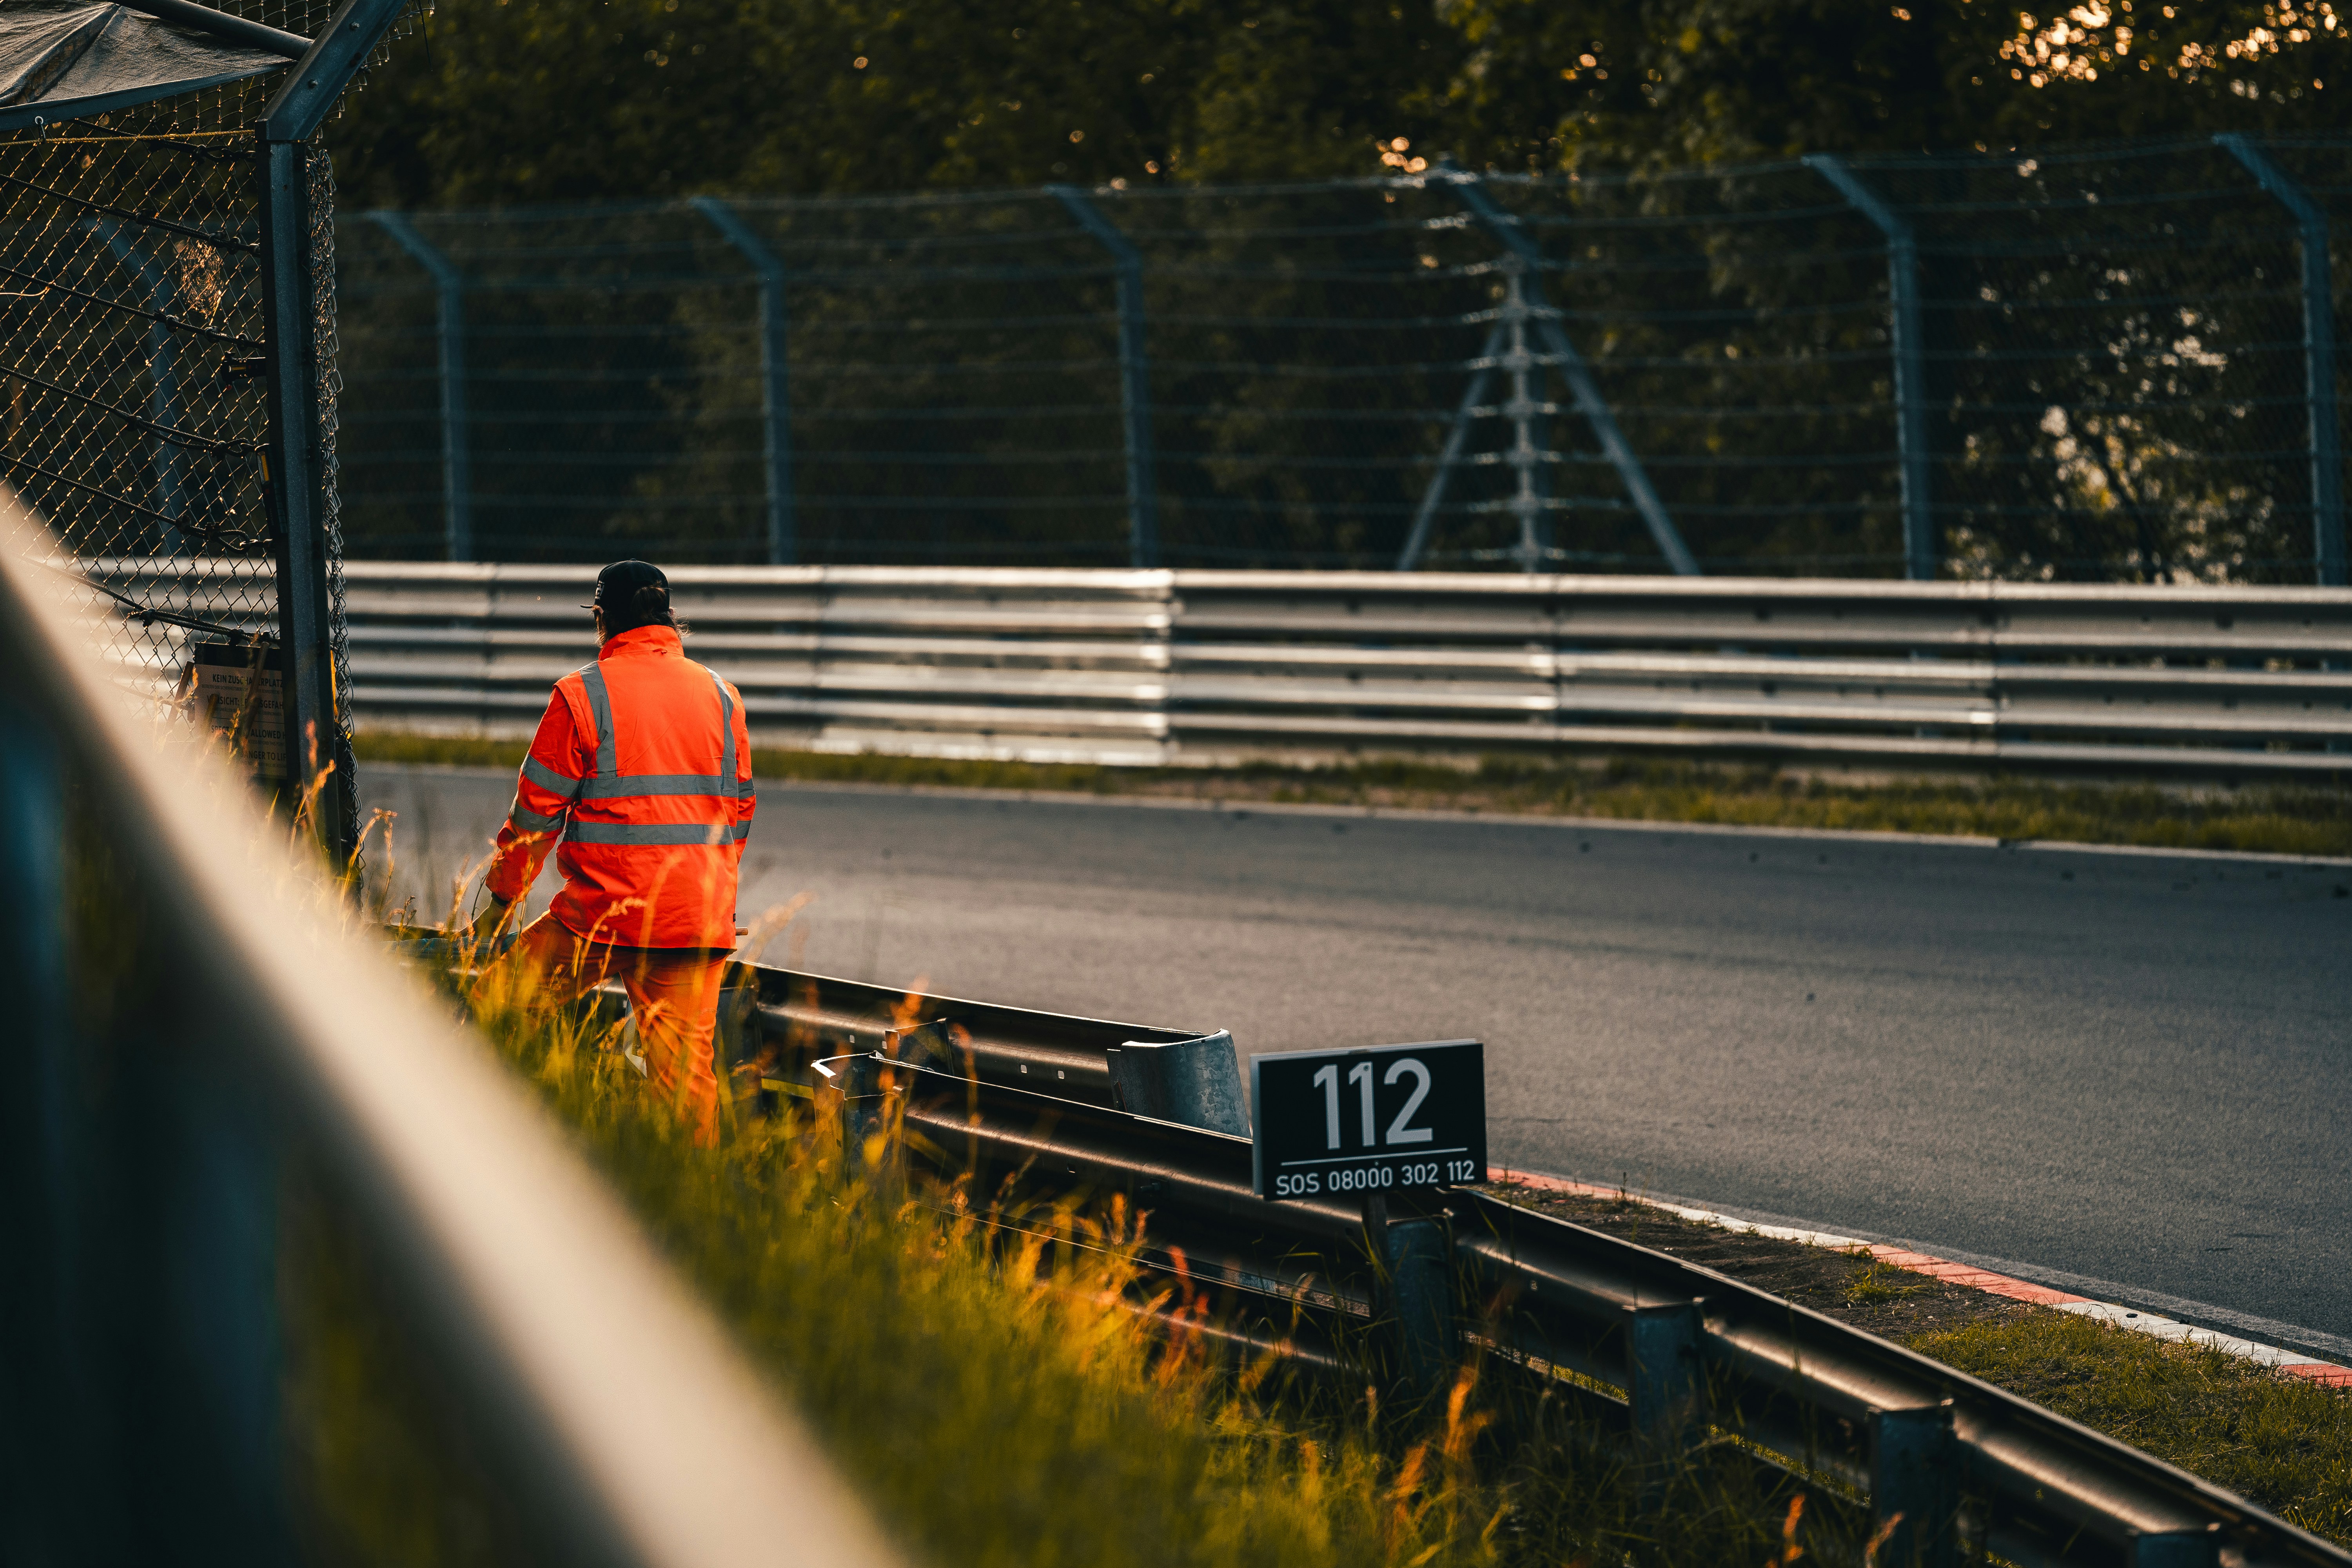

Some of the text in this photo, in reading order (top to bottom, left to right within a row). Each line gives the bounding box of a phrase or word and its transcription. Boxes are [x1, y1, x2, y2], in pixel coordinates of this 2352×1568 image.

[213, 674, 227, 683] KEIN
[207, 695, 240, 706] VRSICHT:
[251, 729, 281, 739] ALLOWED
[267, 752, 275, 760] TO
[1314, 1058, 1433, 1150] 112
[1276, 1160, 1475, 1196] SOS 08000 302 112
